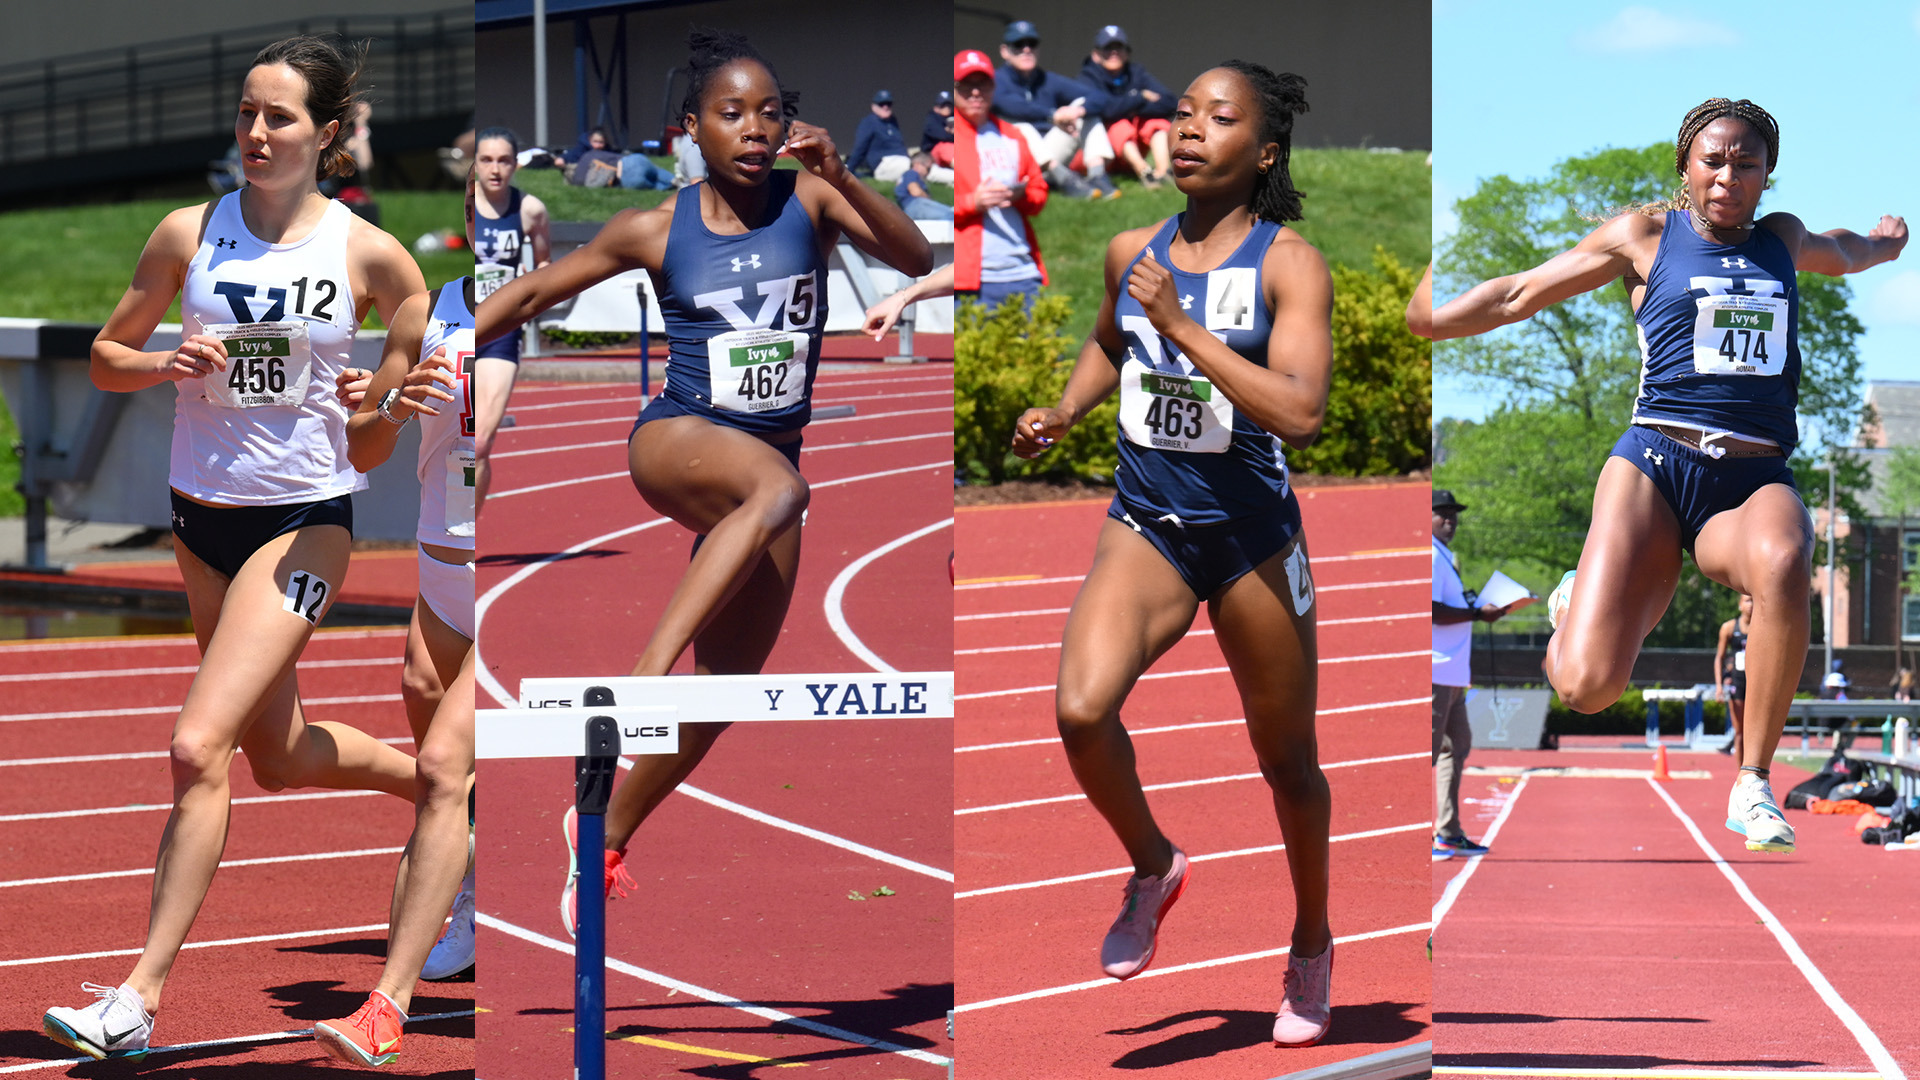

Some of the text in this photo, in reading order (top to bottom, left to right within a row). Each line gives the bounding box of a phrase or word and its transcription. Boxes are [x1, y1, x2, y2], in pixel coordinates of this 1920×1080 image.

[504, 233, 516, 256] 4
[291, 276, 337, 321] 12
[788, 277, 814, 326] 5
[1216, 277, 1248, 326] 4
[1730, 311, 1751, 327] Ivy
[239, 340, 261, 354] Ivy
[747, 347, 768, 362] Ivy
[1718, 329, 1768, 364] 474
[228, 357, 285, 394] 456
[738, 362, 788, 401] 462
[1158, 378, 1183, 395] Ivy
[241, 396, 275, 405] FITZGIBBON
[1144, 396, 1203, 439] 463
[1151, 437, 1183, 448] GUERRIER,
[293, 573, 326, 623] 12
[529, 700, 573, 709] UCS
[764, 682, 927, 715] Y YALE
[624, 726, 670, 738] UCS
[1488, 697, 1524, 741] Y
